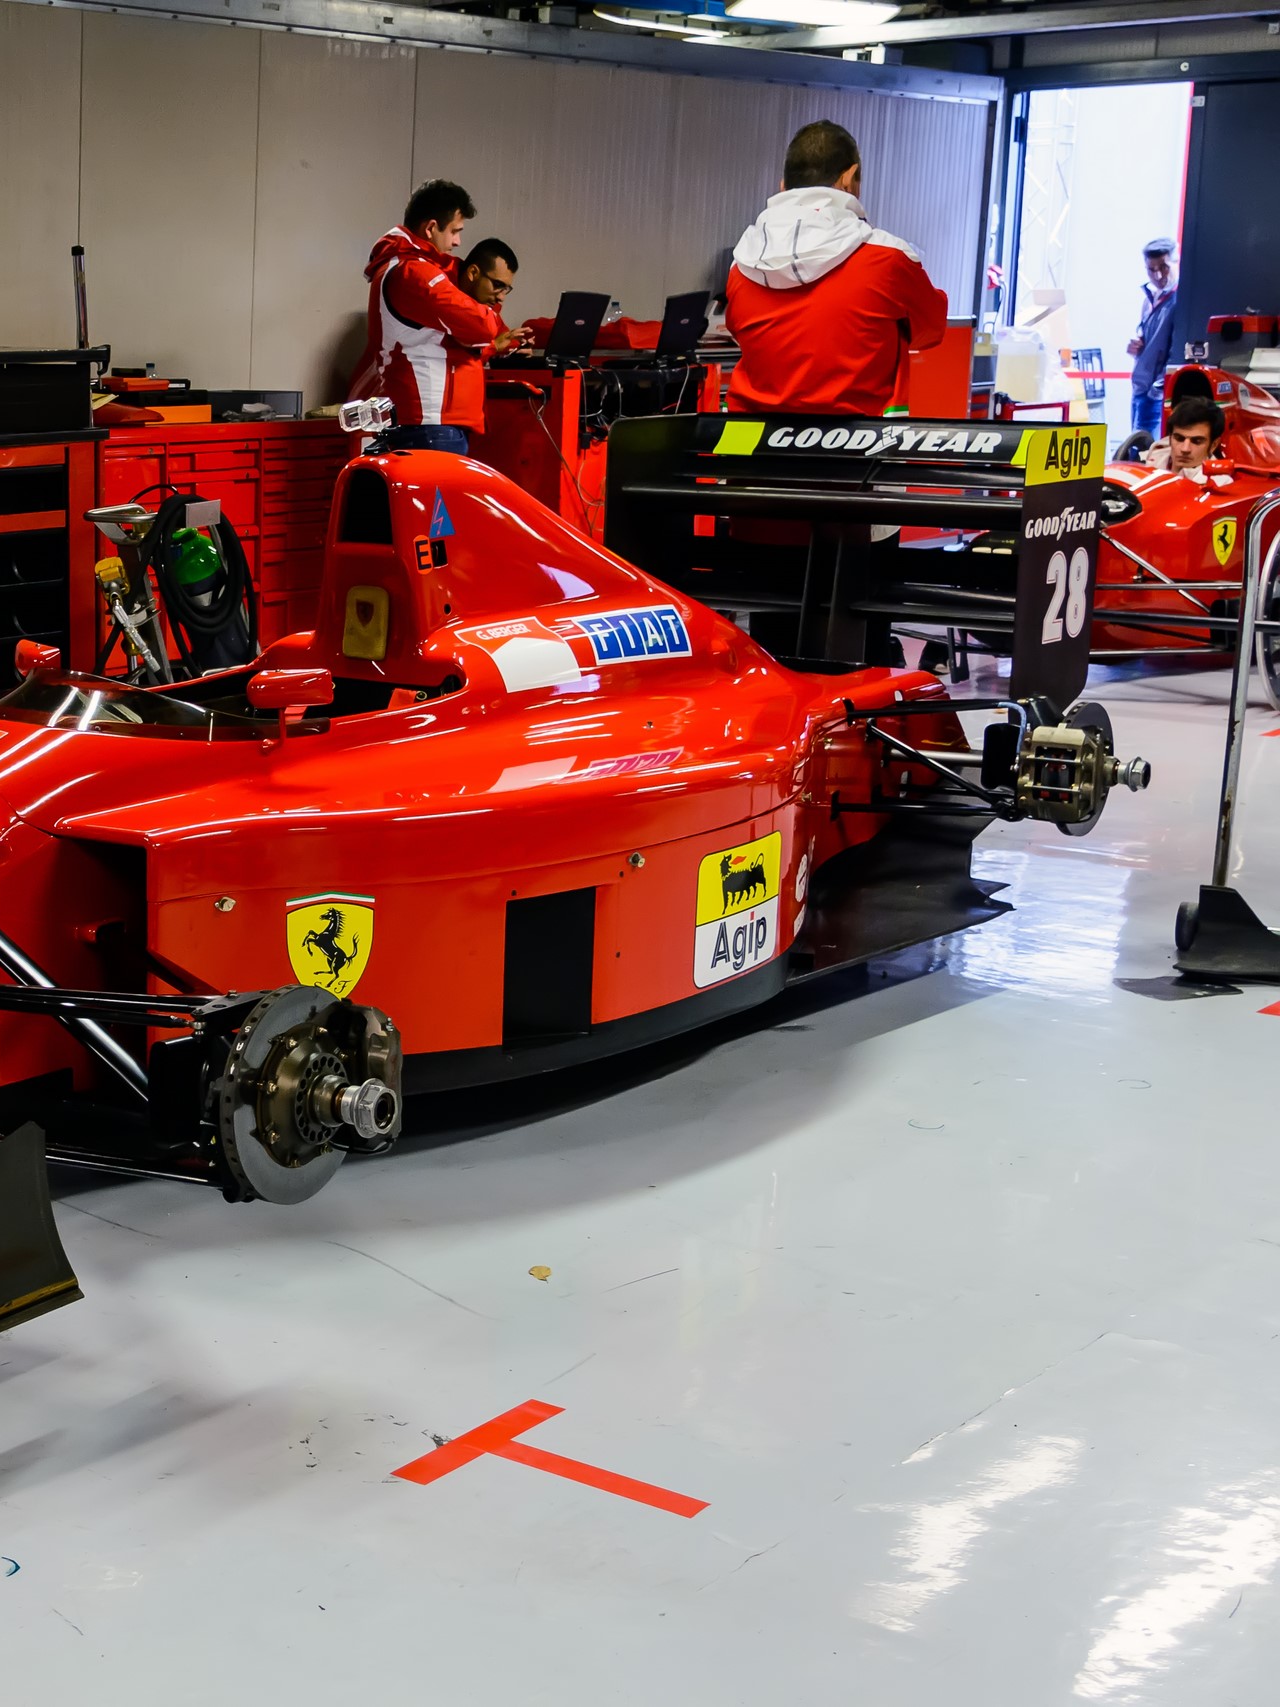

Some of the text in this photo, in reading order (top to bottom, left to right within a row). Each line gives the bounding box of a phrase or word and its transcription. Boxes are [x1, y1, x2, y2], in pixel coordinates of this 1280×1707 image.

[1044, 429, 1091, 478] Agip
[414, 539, 432, 571] E
[1041, 546, 1090, 645] 28
[589, 613, 682, 652] FIAT
[710, 911, 767, 971] Agip
